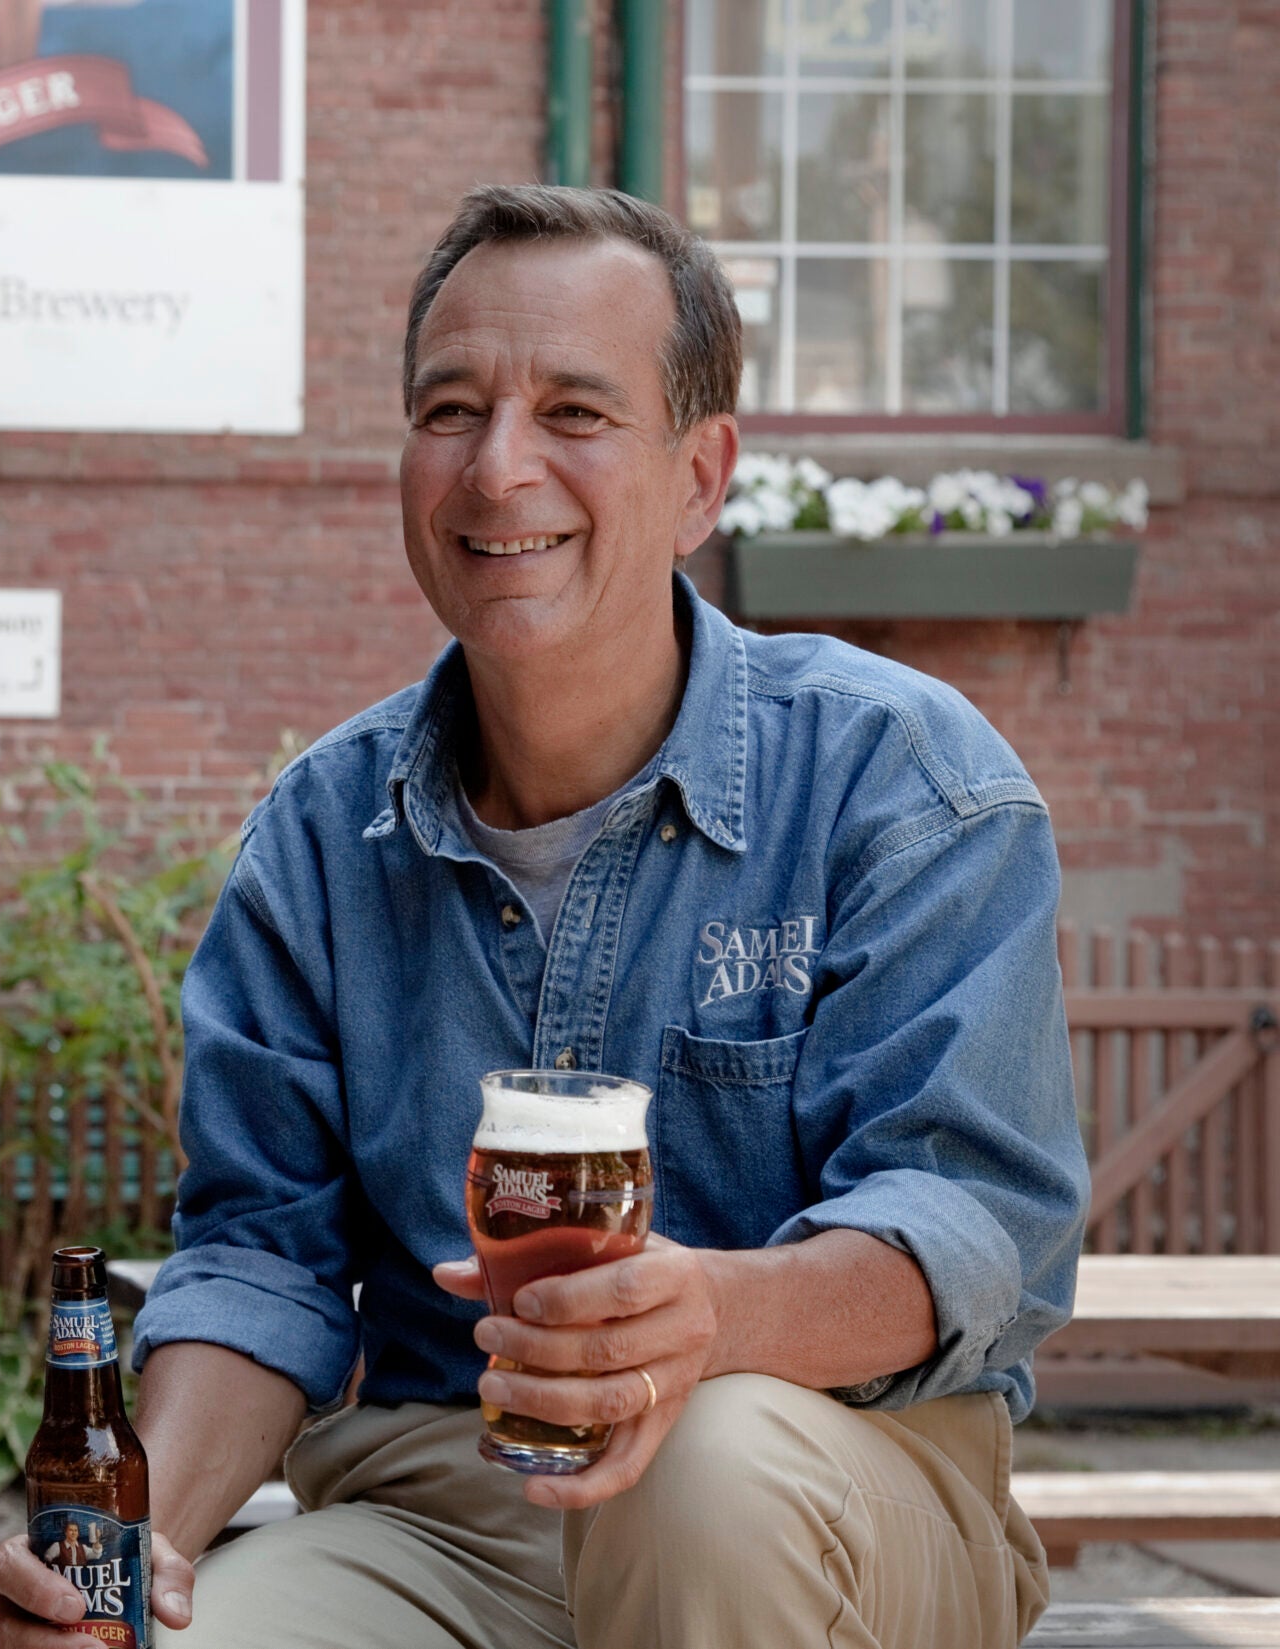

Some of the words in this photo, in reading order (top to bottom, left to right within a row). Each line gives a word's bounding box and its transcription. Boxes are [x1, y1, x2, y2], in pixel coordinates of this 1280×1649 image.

[698, 915, 821, 964] SAMEL
[492, 1163, 554, 1191] SAMUEL
[494, 1180, 548, 1206] ADAMS
[493, 1200, 521, 1211] BOSTON
[522, 1204, 547, 1215] LAGER
[53, 1314, 99, 1329] SAMUEL
[54, 1327, 96, 1341] ADAMS
[54, 1342, 75, 1351] BOSTON
[76, 1342, 96, 1351] LAGER
[51, 1557, 131, 1590] MUEL
